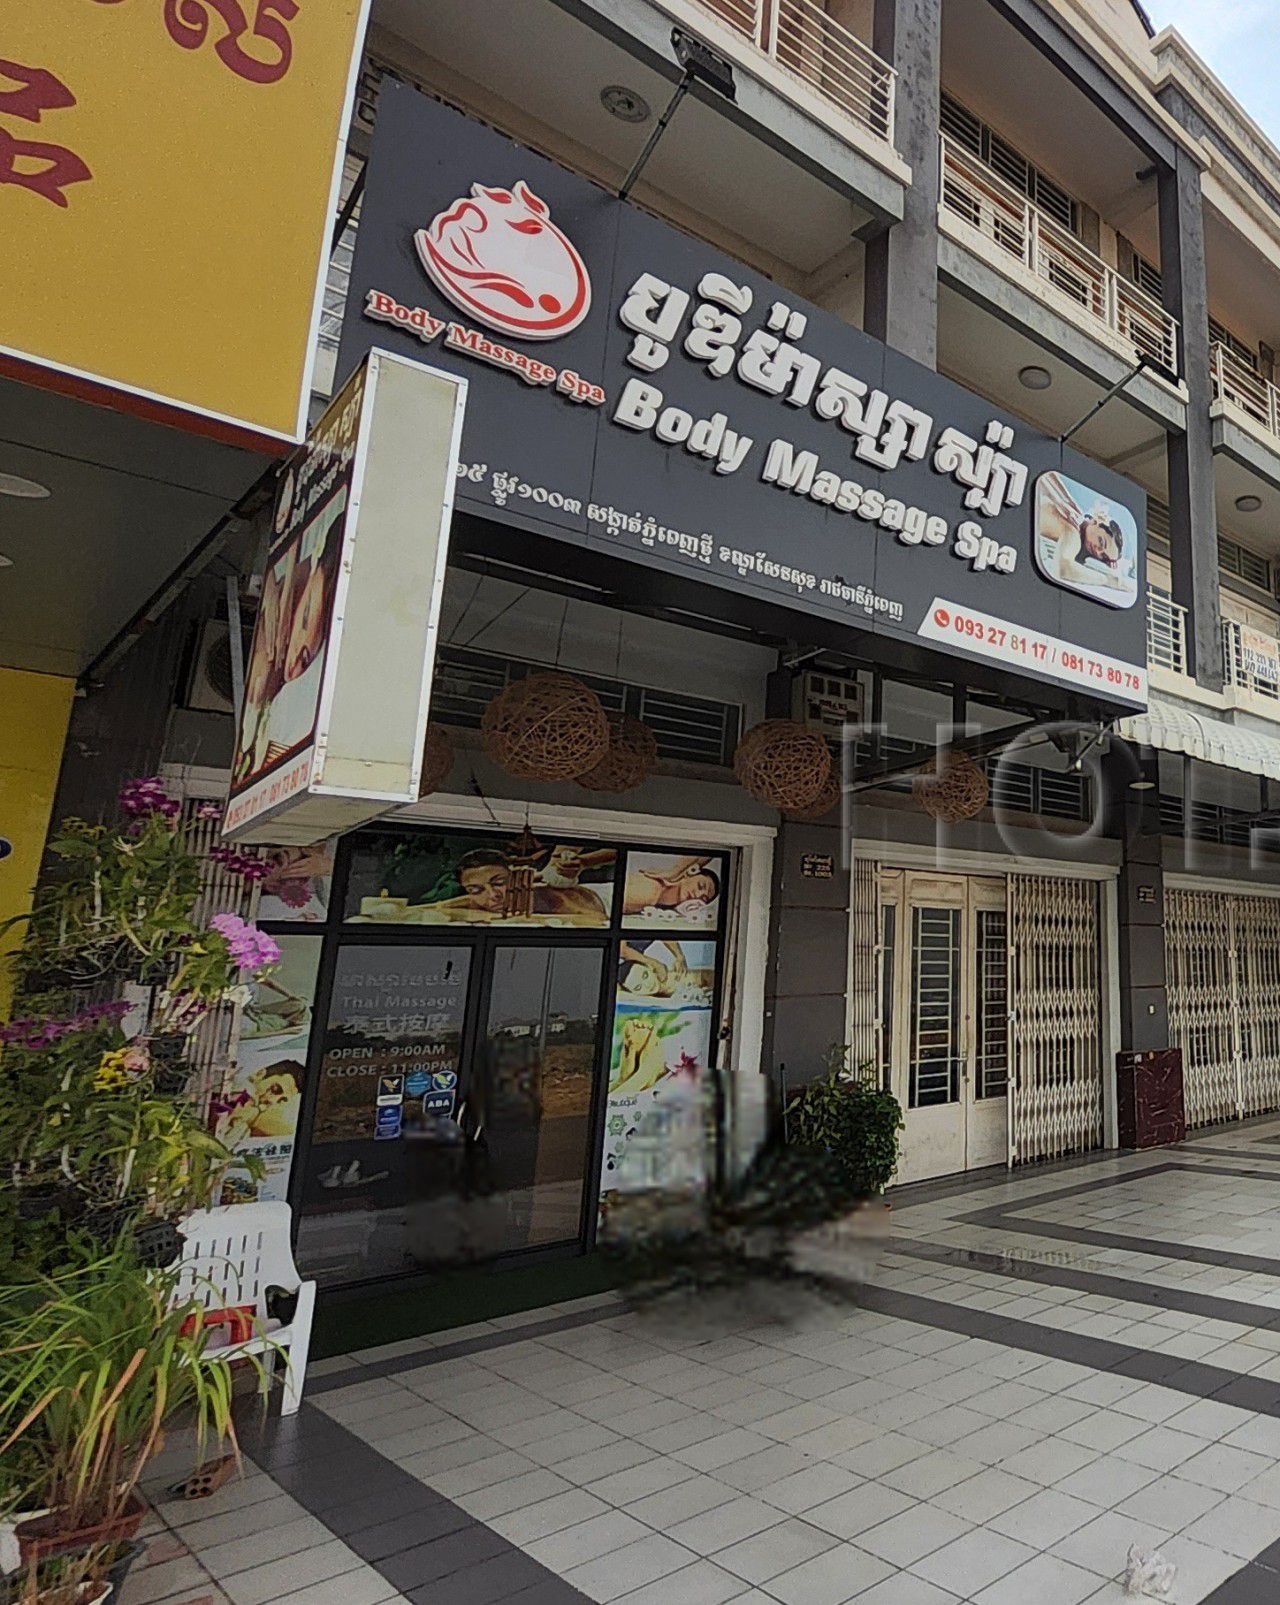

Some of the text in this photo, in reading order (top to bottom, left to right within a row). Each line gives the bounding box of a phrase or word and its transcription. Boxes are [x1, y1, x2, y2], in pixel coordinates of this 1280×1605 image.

[366, 290, 605, 403] Body Massage Spa
[613, 378, 1018, 574] Body Massage Spa
[954, 615, 984, 640] 093
[988, 627, 1007, 647] 27
[1010, 634, 1027, 654] 81
[1031, 642, 1047, 660] 17
[1061, 651, 1084, 673] 081
[1087, 660, 1103, 678] 73
[1107, 667, 1122, 684] 80
[1125, 673, 1140, 690] 78
[385, 996, 457, 1010] Massage
[328, 1046, 373, 1060] OPEN
[389, 1043, 446, 1057] 9:00AM
[326, 1064, 378, 1079] CLOSE
[391, 1060, 454, 1074] 11:00PM
[427, 1099, 450, 1108] ABA
